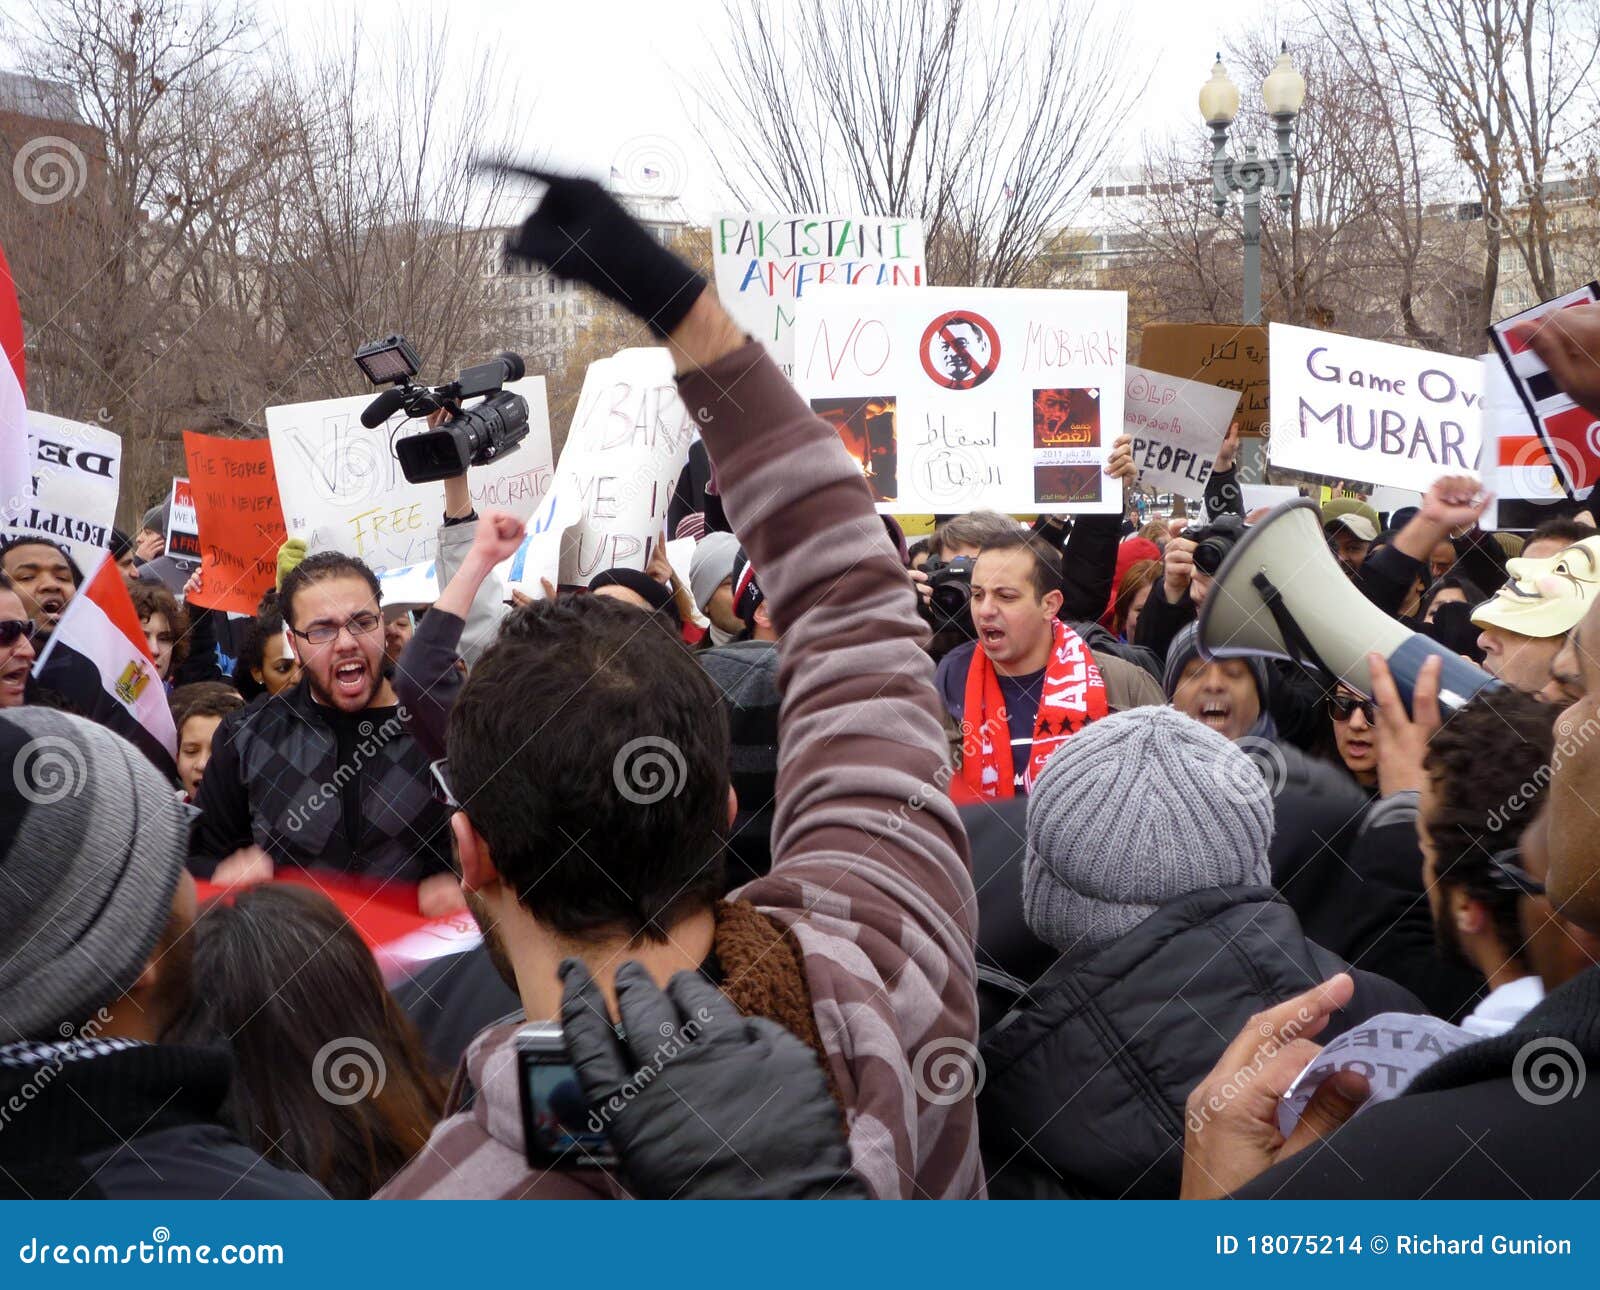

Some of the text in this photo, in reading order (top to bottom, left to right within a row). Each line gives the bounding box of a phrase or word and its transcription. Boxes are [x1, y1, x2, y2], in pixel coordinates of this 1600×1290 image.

[719, 218, 912, 260] PAKISTANI
[806, 318, 891, 381] NO
[1127, 375, 1177, 406] OLD
[1306, 347, 1405, 395] Game
[191, 452, 217, 475] THE
[1132, 437, 1214, 484] PEOPLE
[174, 511, 189, 524] WE
